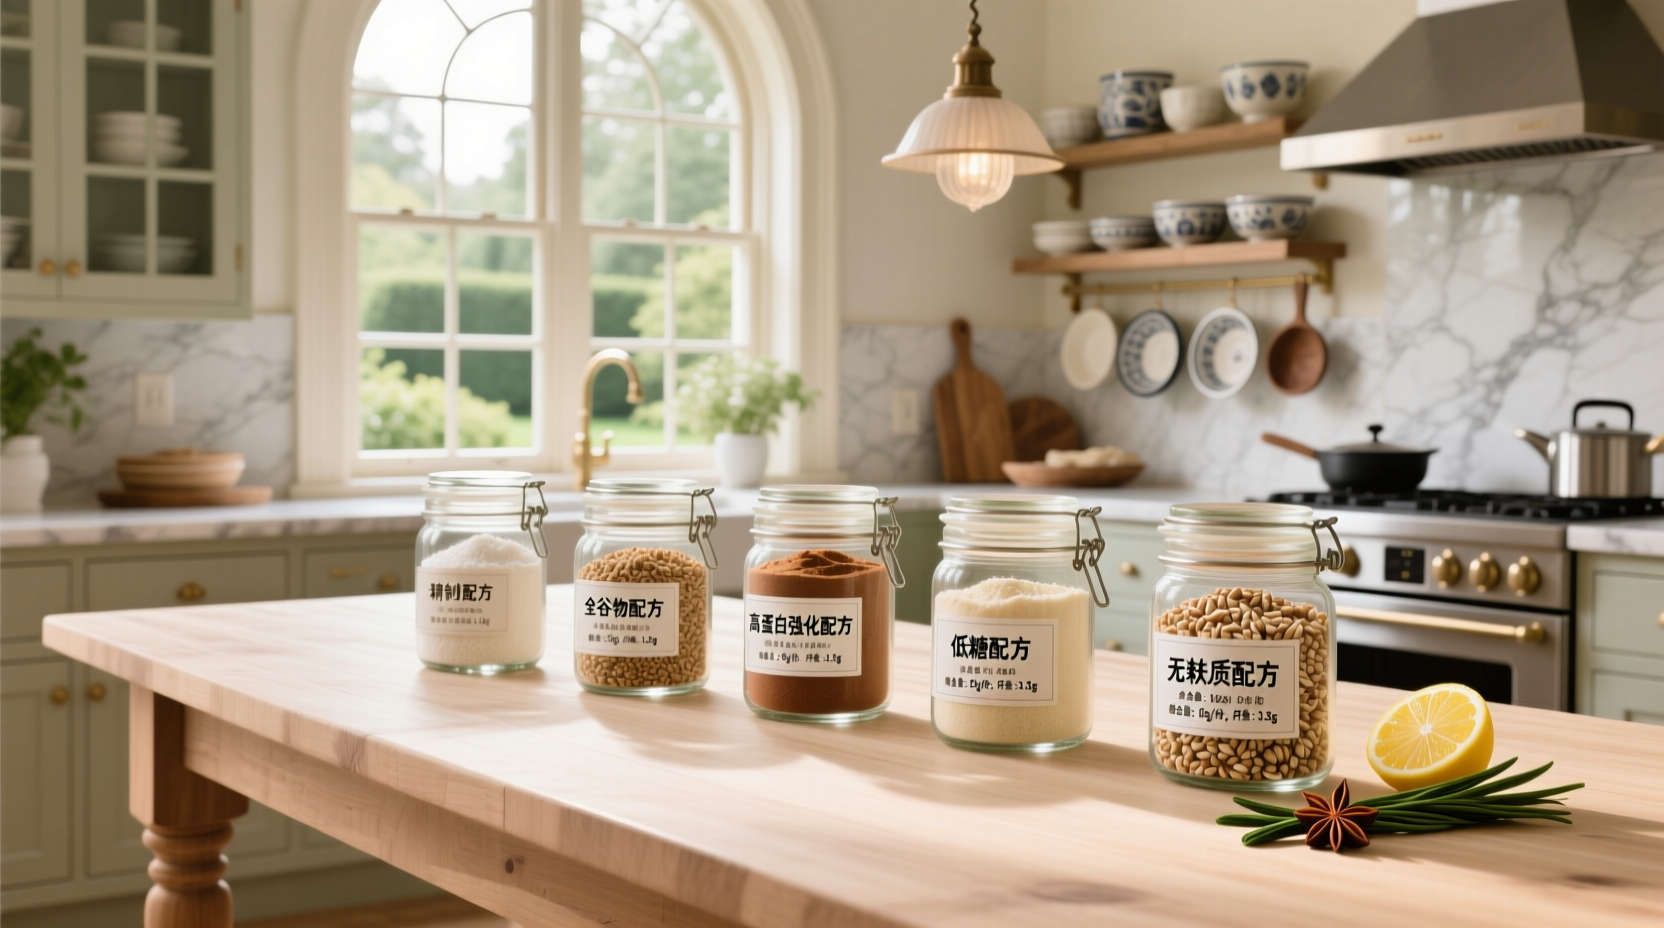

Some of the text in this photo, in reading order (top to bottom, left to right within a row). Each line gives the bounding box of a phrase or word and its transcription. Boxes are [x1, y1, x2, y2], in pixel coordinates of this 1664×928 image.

[585, 597, 664, 618] 全谷物配方
[749, 612, 853, 636] 高蛋白强化配方
[951, 634, 1031, 661] 低糖配方
[1167, 657, 1279, 688] 无麸质配方
